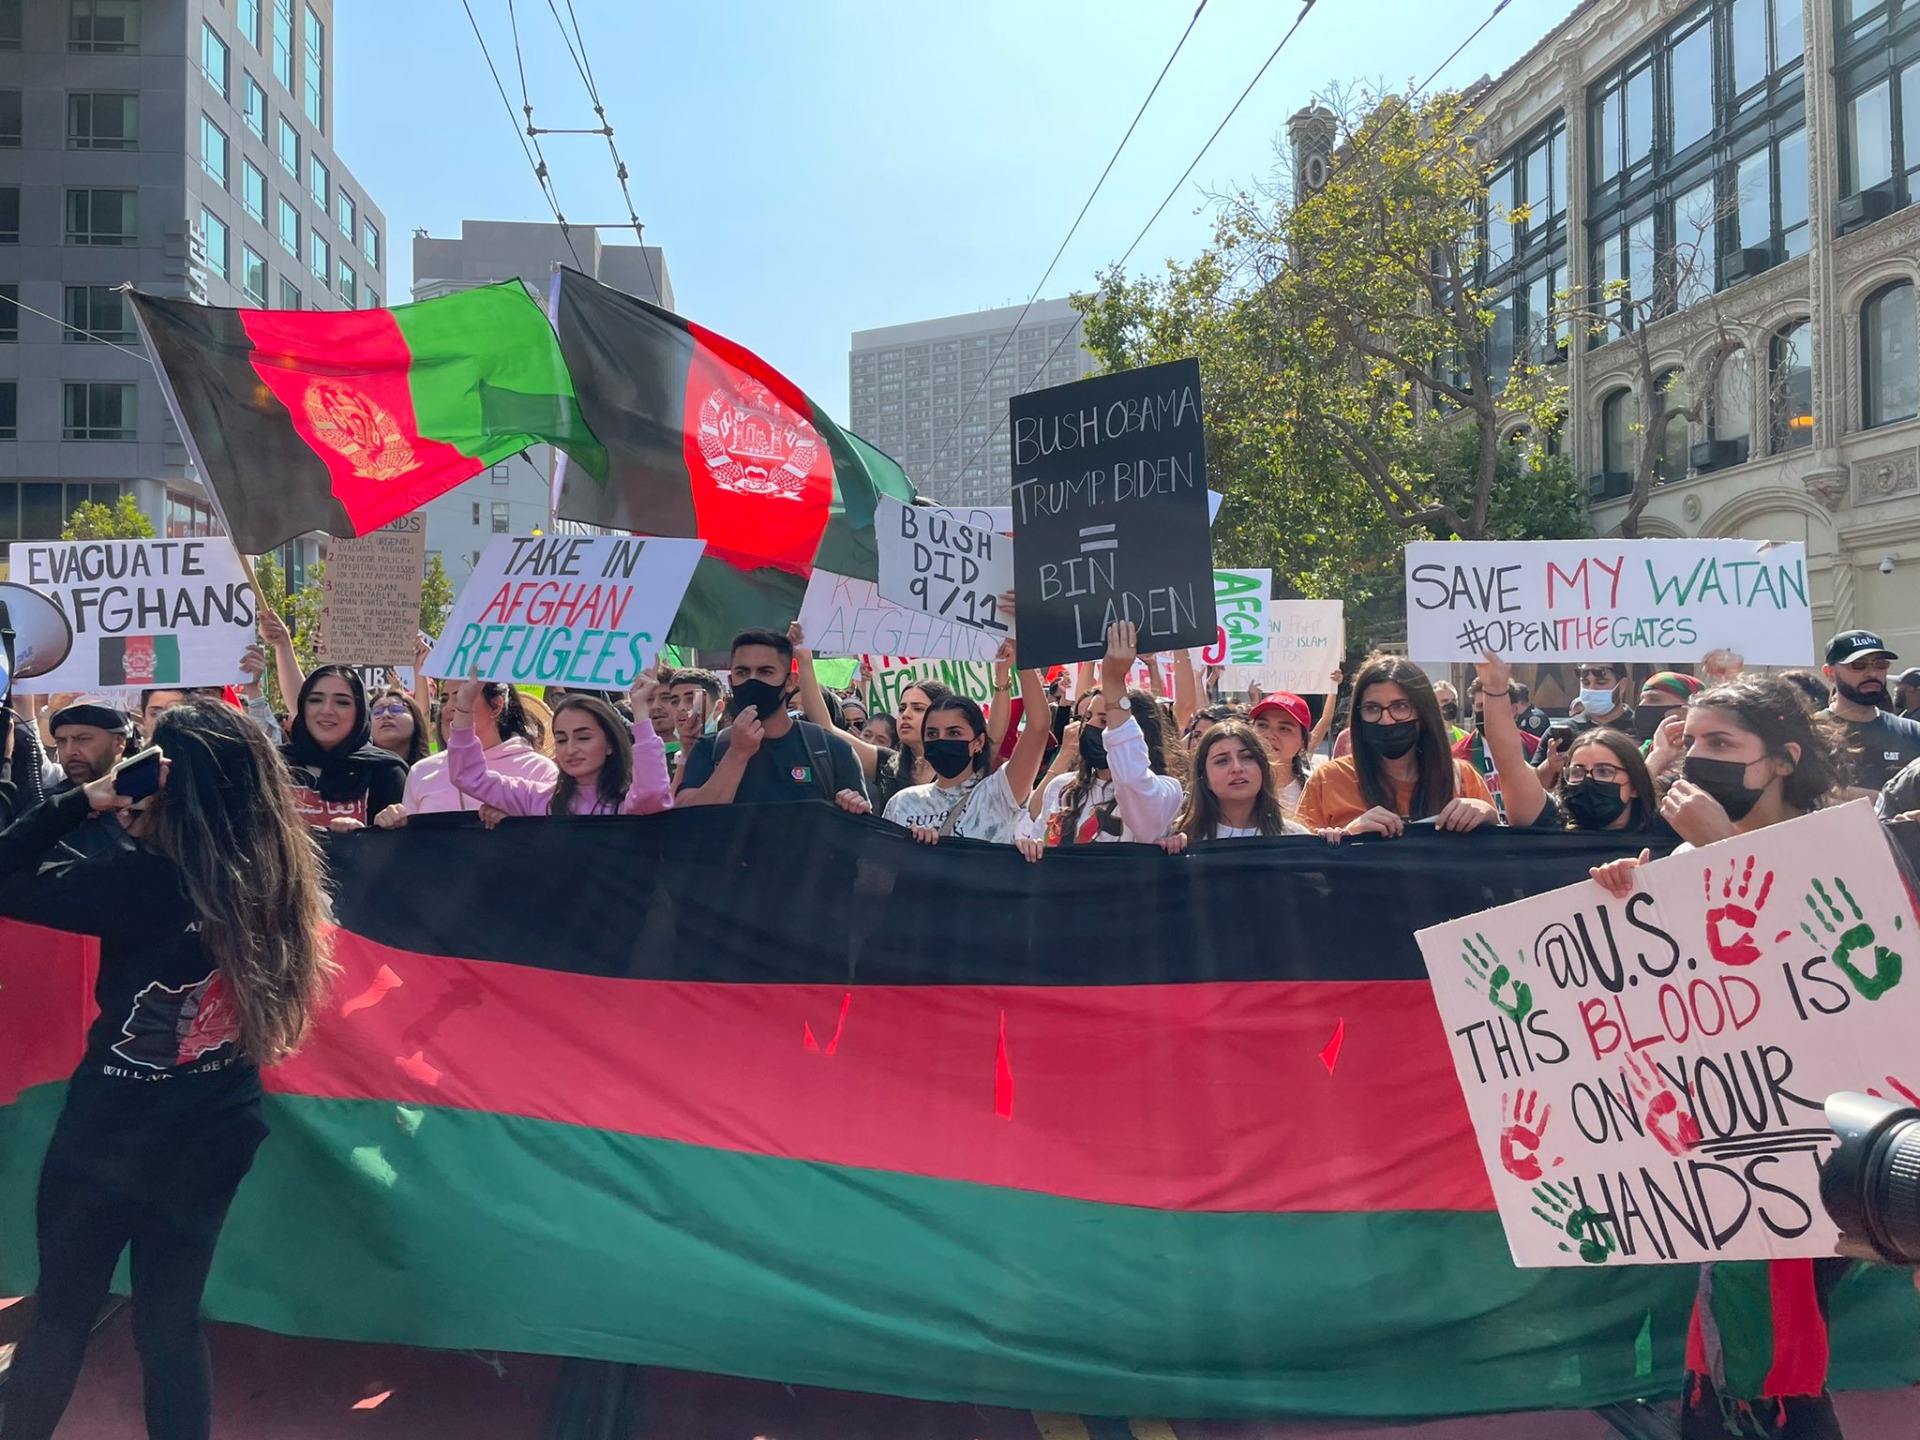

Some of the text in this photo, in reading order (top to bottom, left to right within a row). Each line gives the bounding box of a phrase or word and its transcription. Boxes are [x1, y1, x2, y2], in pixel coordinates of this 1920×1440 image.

[190, 219, 208, 306] LACE
[1105, 386, 1198, 439] OBAMA
[1114, 452, 1193, 502] BIDEN
[378, 556, 404, 565] POLICY
[503, 537, 646, 579] TAKE IN
[901, 504, 992, 561] BUSH
[28, 542, 205, 585] EVACUATE
[335, 581, 355, 590] HOLD
[359, 582, 397, 592] TALIBAN
[913, 542, 980, 585] DID
[1039, 551, 1116, 601] BIN
[1411, 556, 1809, 613] SAVE MY WATAN
[478, 582, 634, 631] AFGHAN
[909, 576, 1009, 632] 9/11
[1073, 583, 1197, 649] LADEN
[1213, 572, 1264, 664] AFGAN
[444, 623, 653, 687] REFUGEES
[815, 605, 1001, 661] AFGHANS
[1296, 636, 1328, 648] ISLAM
[1883, 751, 1900, 761] CAT
[1534, 892, 1697, 993] @U.S.
[1455, 955, 1851, 1084] THIS BLOOD IS
[1570, 1045, 1825, 1144] ON YOUR
[1572, 1150, 1824, 1260] HANDS
